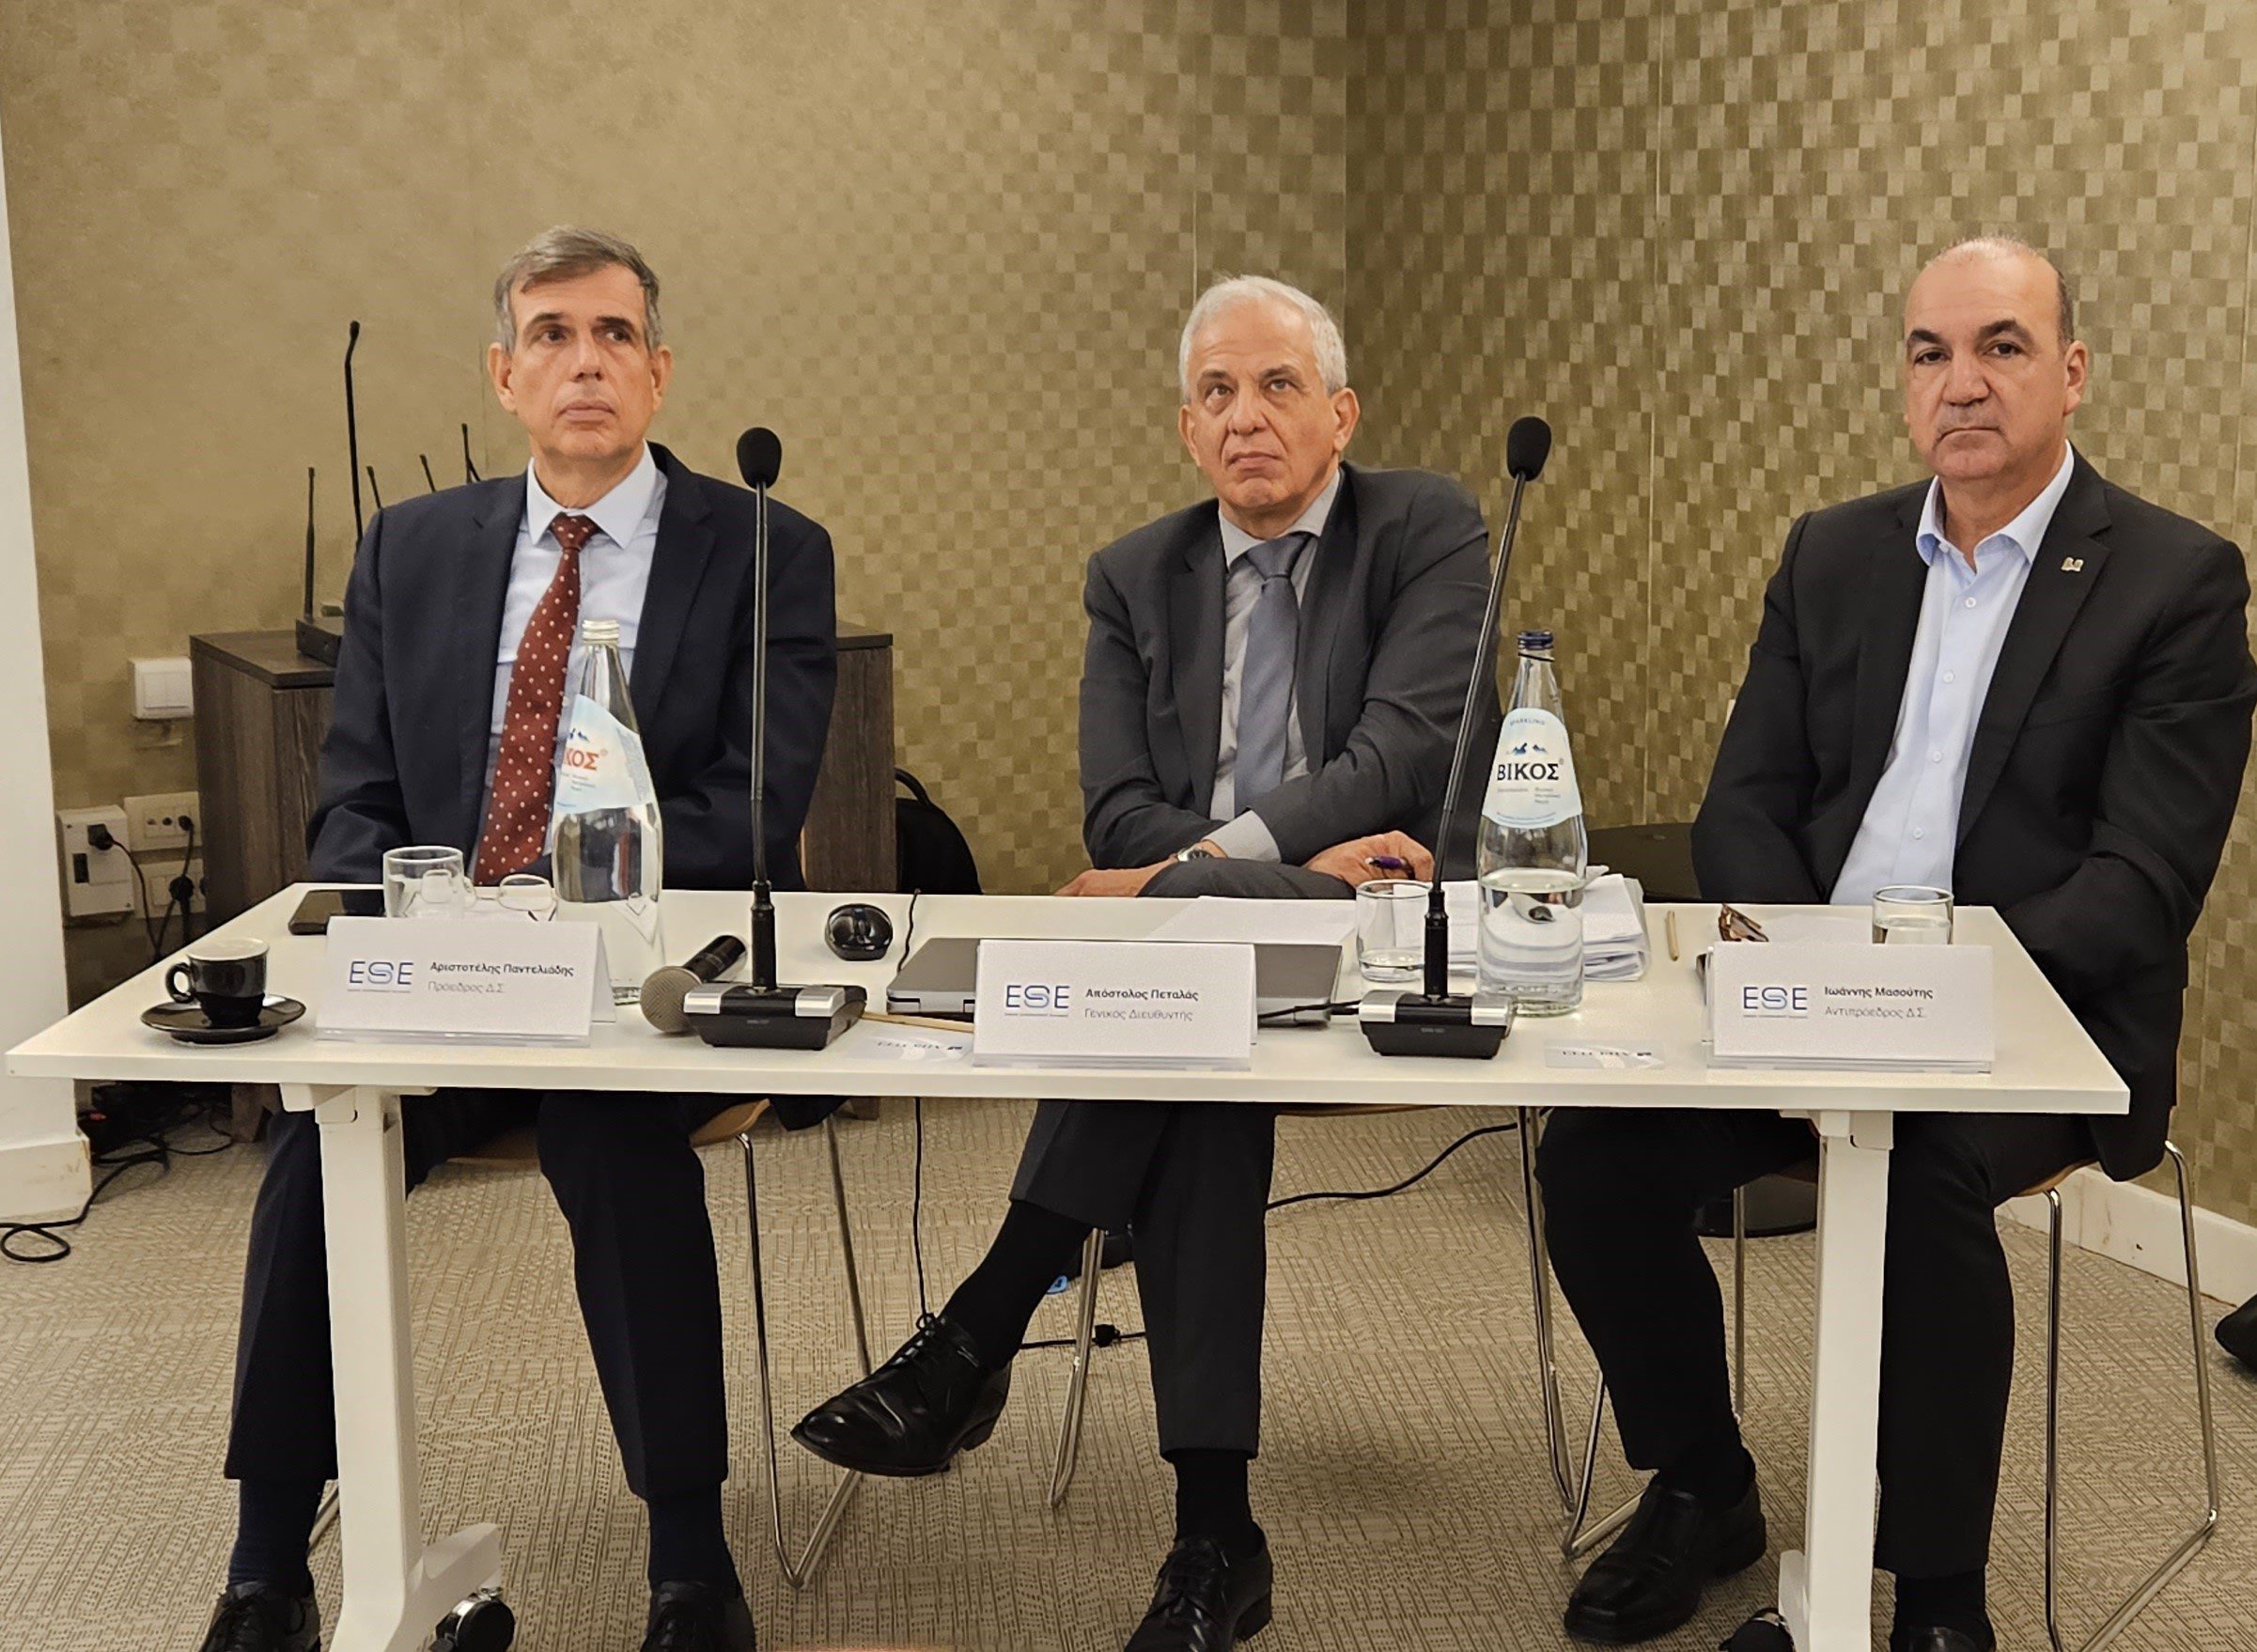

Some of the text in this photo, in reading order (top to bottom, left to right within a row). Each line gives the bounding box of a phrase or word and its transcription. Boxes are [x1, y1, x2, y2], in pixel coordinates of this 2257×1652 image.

[1497, 763, 1560, 781] ΒΙΚΟΣ
[430, 961, 575, 977] Αριστοτέλης Παντελιάδης
[1085, 988, 1199, 1002] Απόστολος Πεταλάς
[1824, 986, 1934, 1000] Ιωάννης Μασούτης
